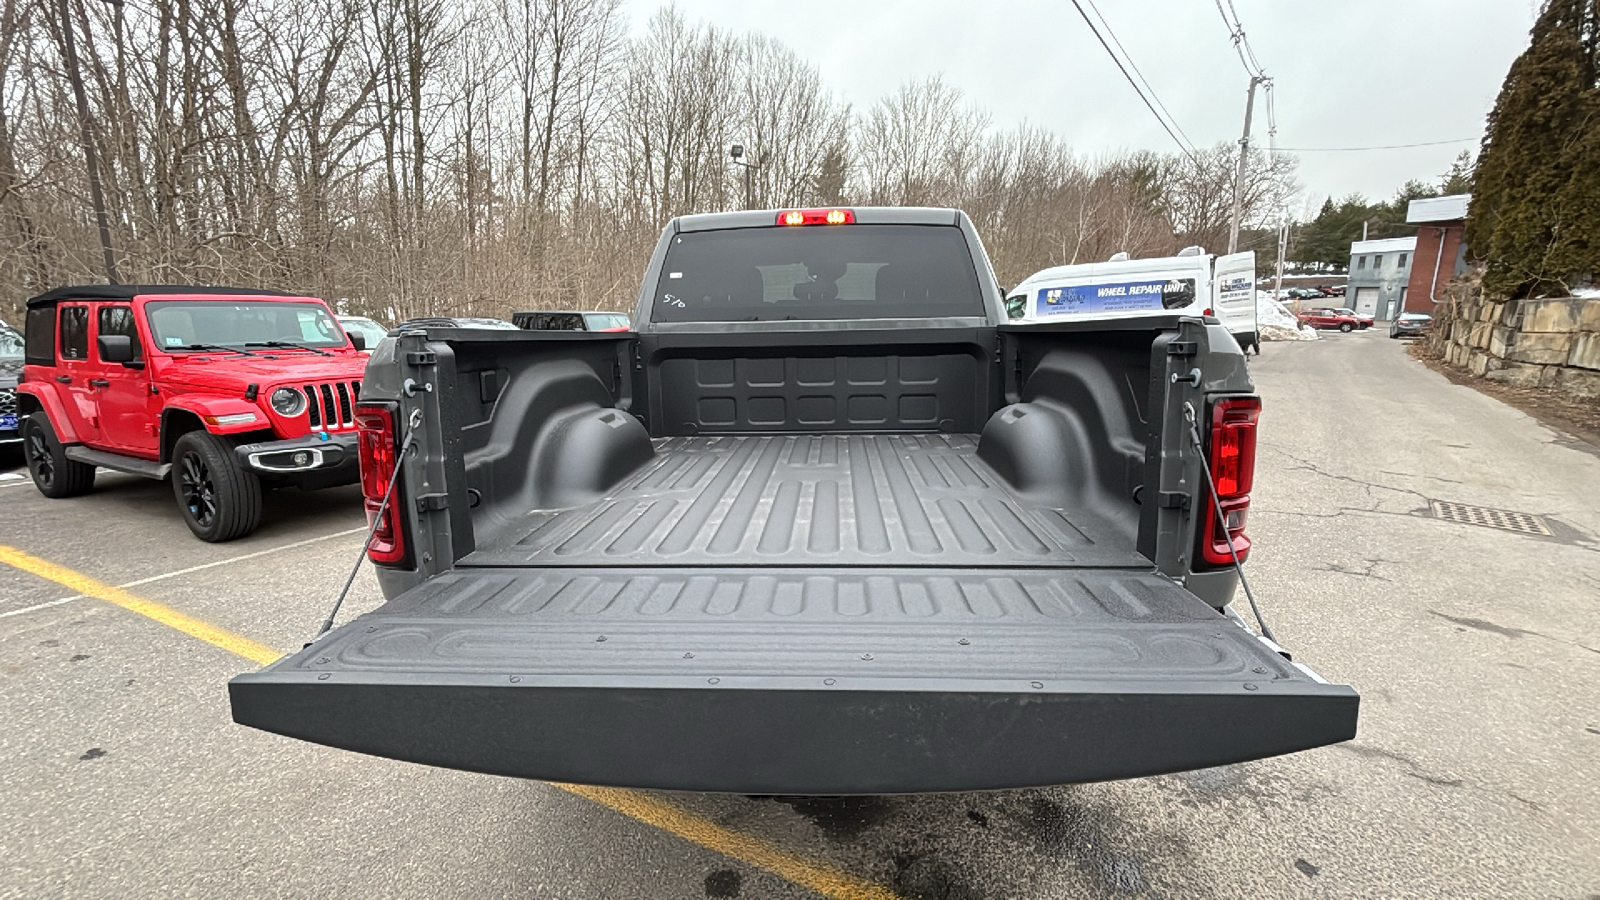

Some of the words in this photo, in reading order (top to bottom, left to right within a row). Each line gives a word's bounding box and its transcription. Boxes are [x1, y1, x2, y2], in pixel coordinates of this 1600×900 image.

[1098, 286, 1127, 298] WHEEL
[1128, 284, 1162, 295] REPAIR
[1163, 282, 1187, 293] UNIT
